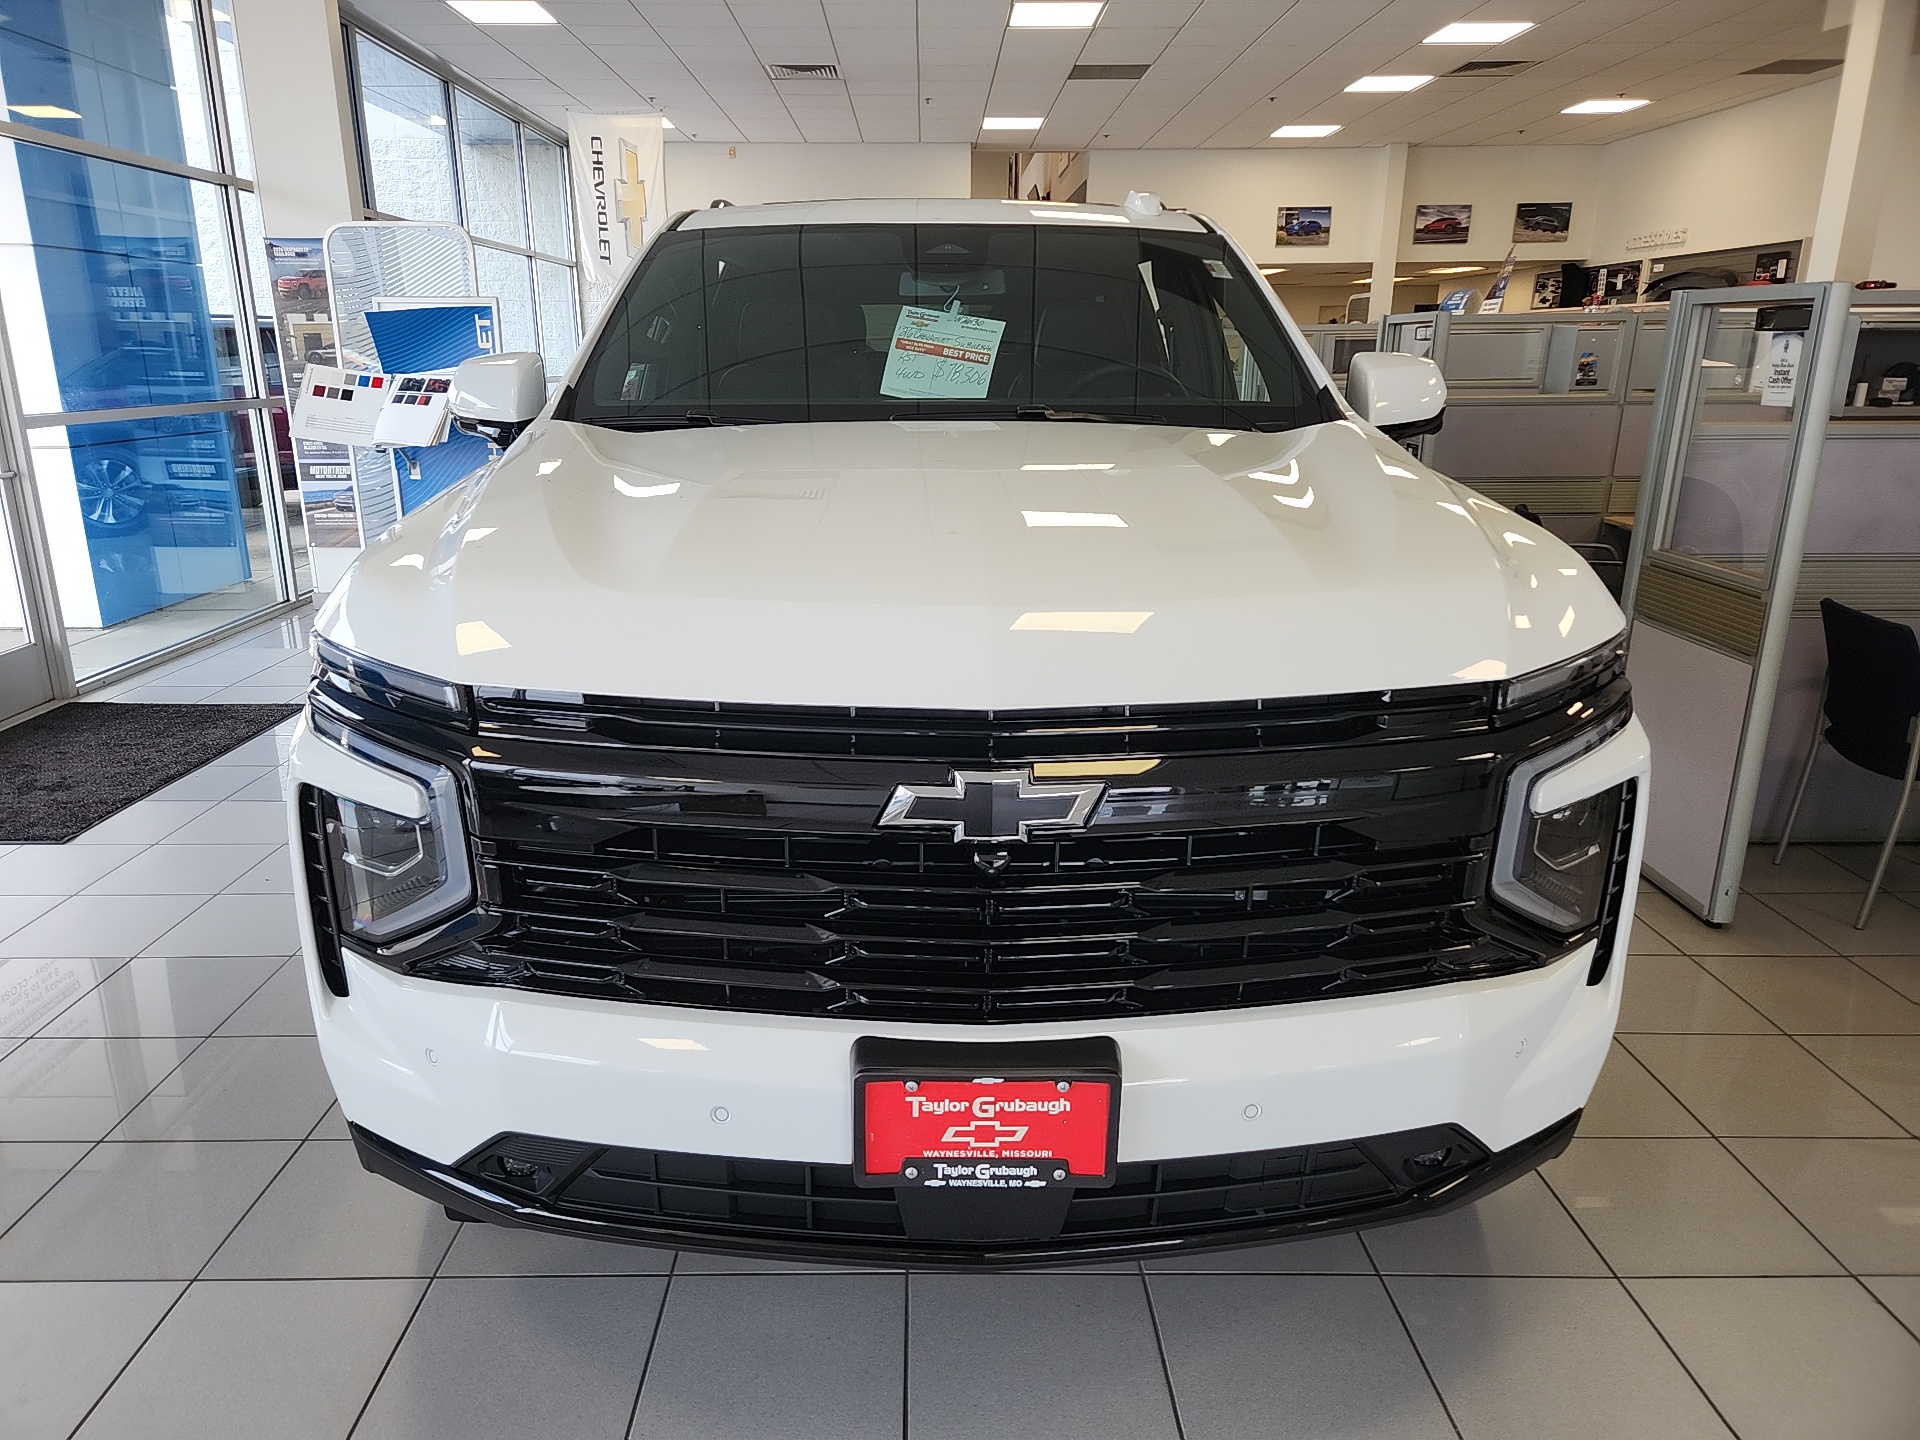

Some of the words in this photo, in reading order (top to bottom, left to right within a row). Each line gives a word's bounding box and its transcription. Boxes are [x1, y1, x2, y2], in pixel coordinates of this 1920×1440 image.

[590, 136, 612, 265] CHEVROLET
[943, 348, 964, 357] BEST
[964, 352, 990, 363] PRICE
[896, 366, 925, 379] 4WD
[1774, 368, 1790, 376] Instant
[1781, 376, 1793, 384] Offer
[310, 466, 350, 474] MOTORTREND
[905, 1096, 970, 1118] Taylor
[972, 1096, 1071, 1118] Grubaugh
[922, 1150, 998, 1158] WAYNESVILLE,
[1002, 1150, 1052, 1158] MISSOURI
[933, 1164, 974, 1178] Taylor
[975, 1164, 1038, 1179] Grubaugh
[948, 1180, 1008, 1188] WAYNESVILLE,
